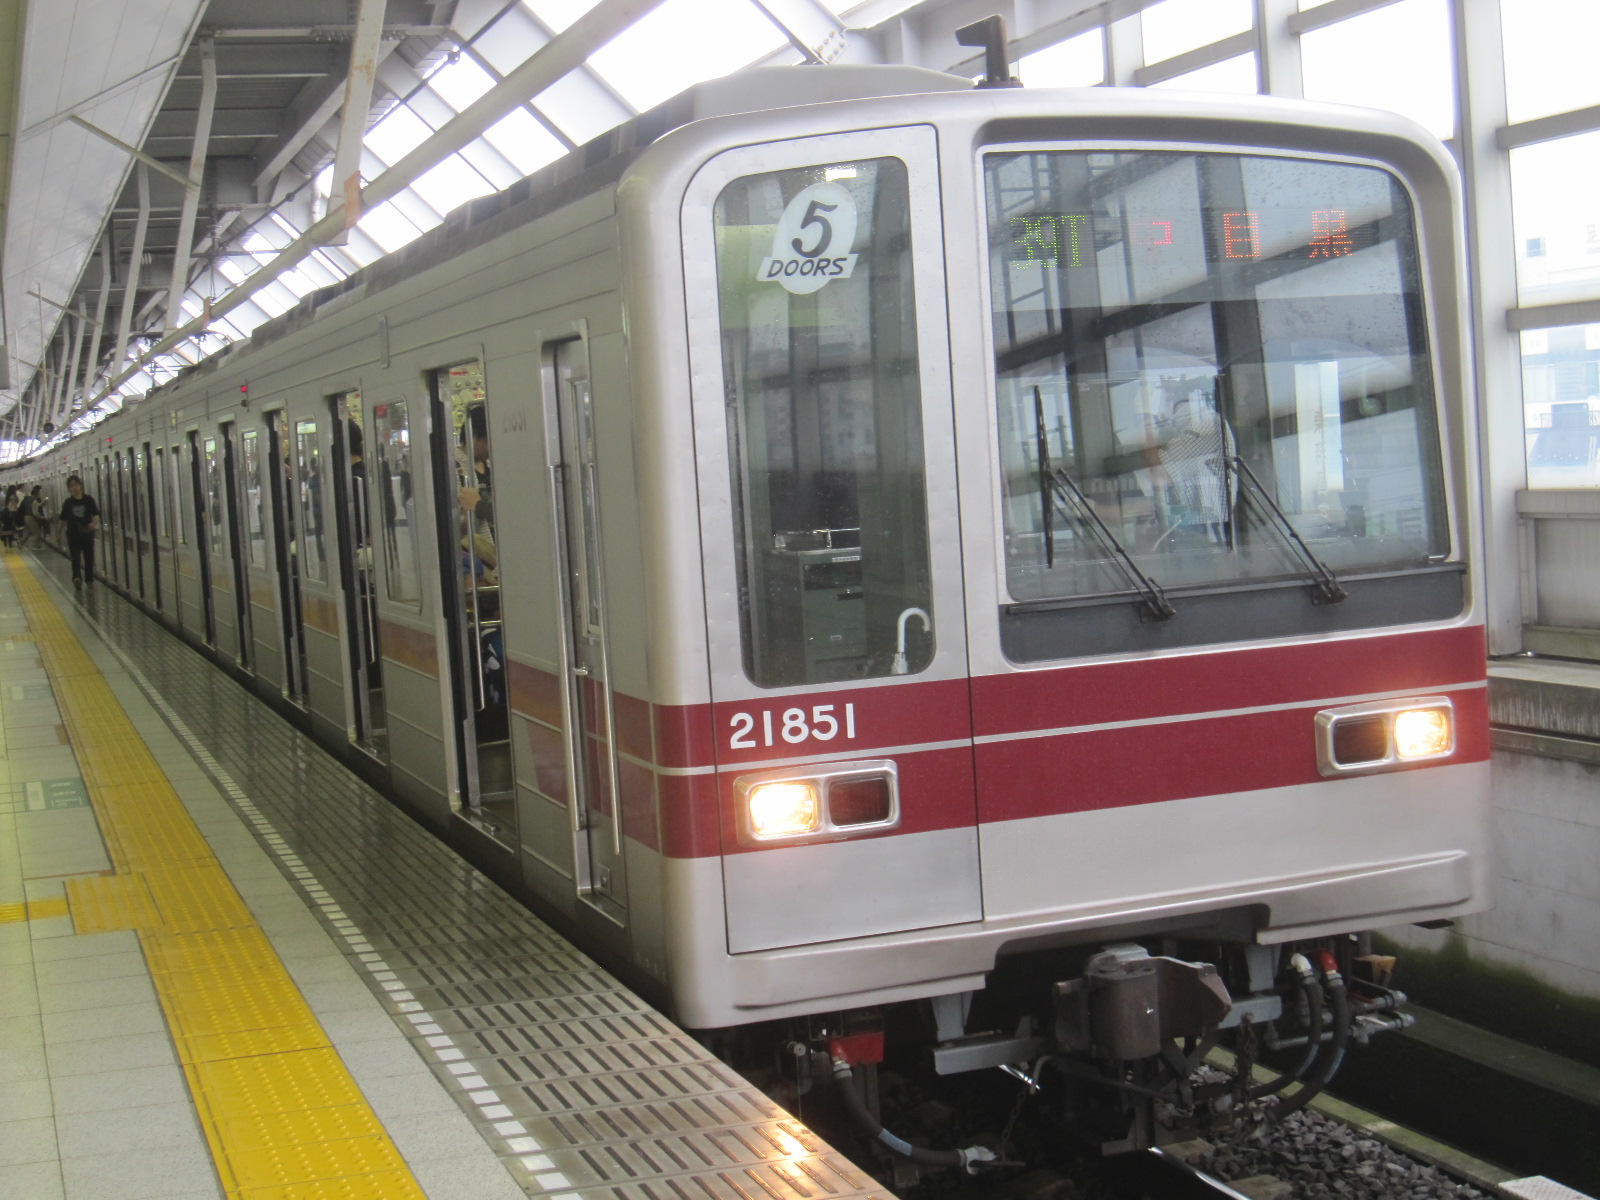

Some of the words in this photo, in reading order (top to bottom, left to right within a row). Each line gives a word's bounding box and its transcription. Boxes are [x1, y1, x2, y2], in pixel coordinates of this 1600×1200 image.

[791, 199, 838, 259] 5
[766, 257, 848, 279] DOORS
[729, 702, 856, 750] 21851
